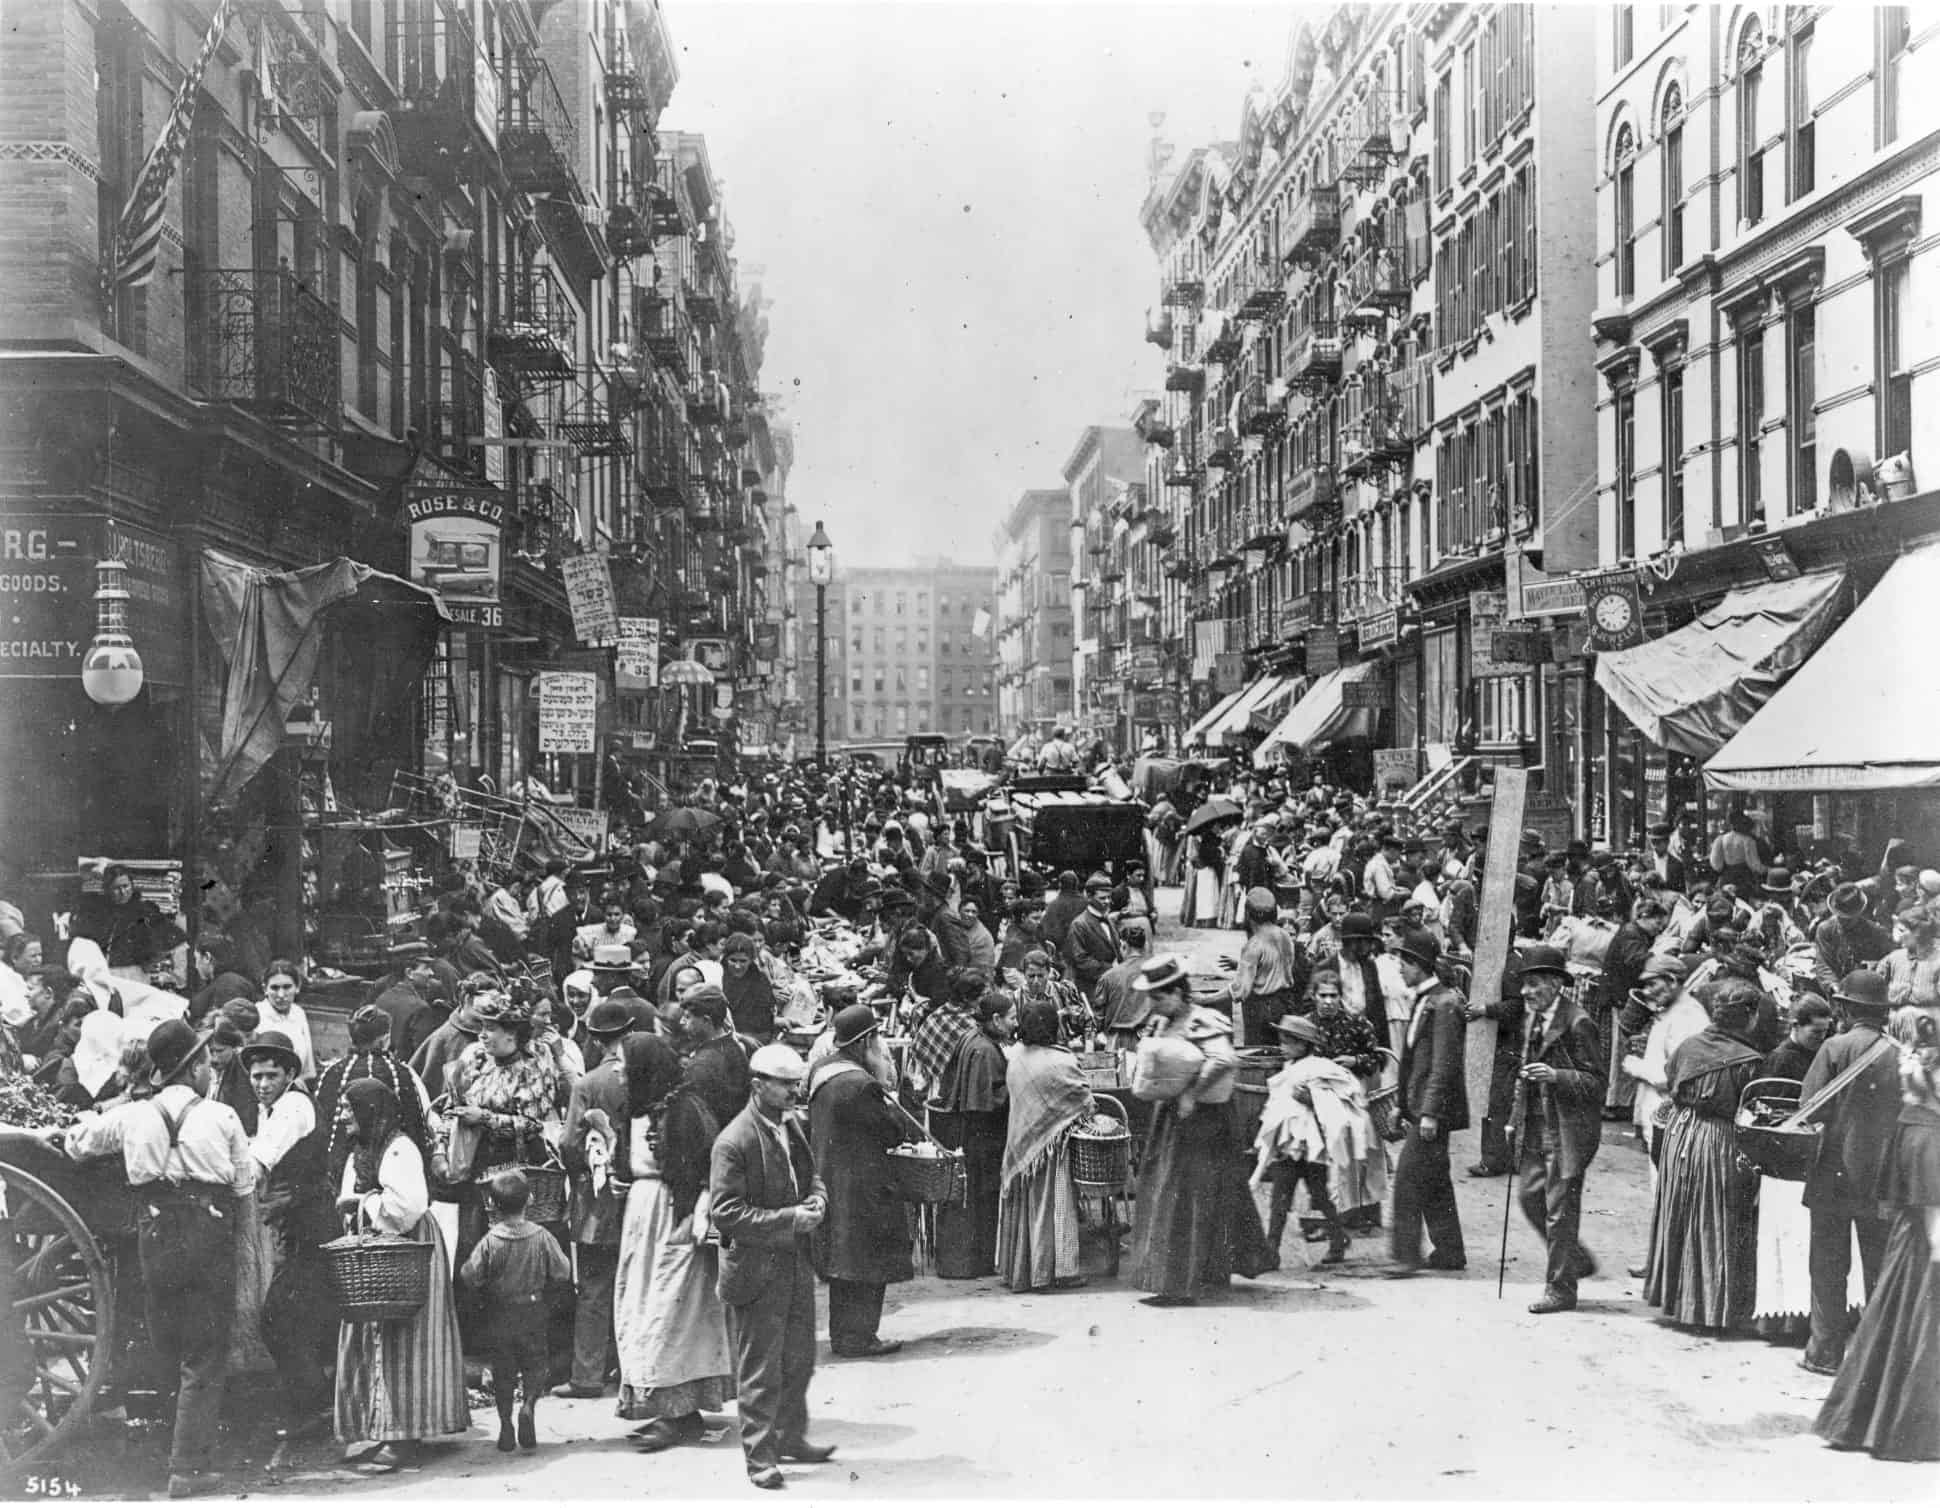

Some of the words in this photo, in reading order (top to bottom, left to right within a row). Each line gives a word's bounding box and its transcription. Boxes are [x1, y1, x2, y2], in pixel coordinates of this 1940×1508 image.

[408, 496, 458, 518] ROSE
[463, 496, 476, 512] &
[0, 574, 68, 593] GOODS.
[449, 607, 480, 624] ESALE.
[481, 607, 502, 627] 36
[0, 640, 81, 657] ECIALTY.
